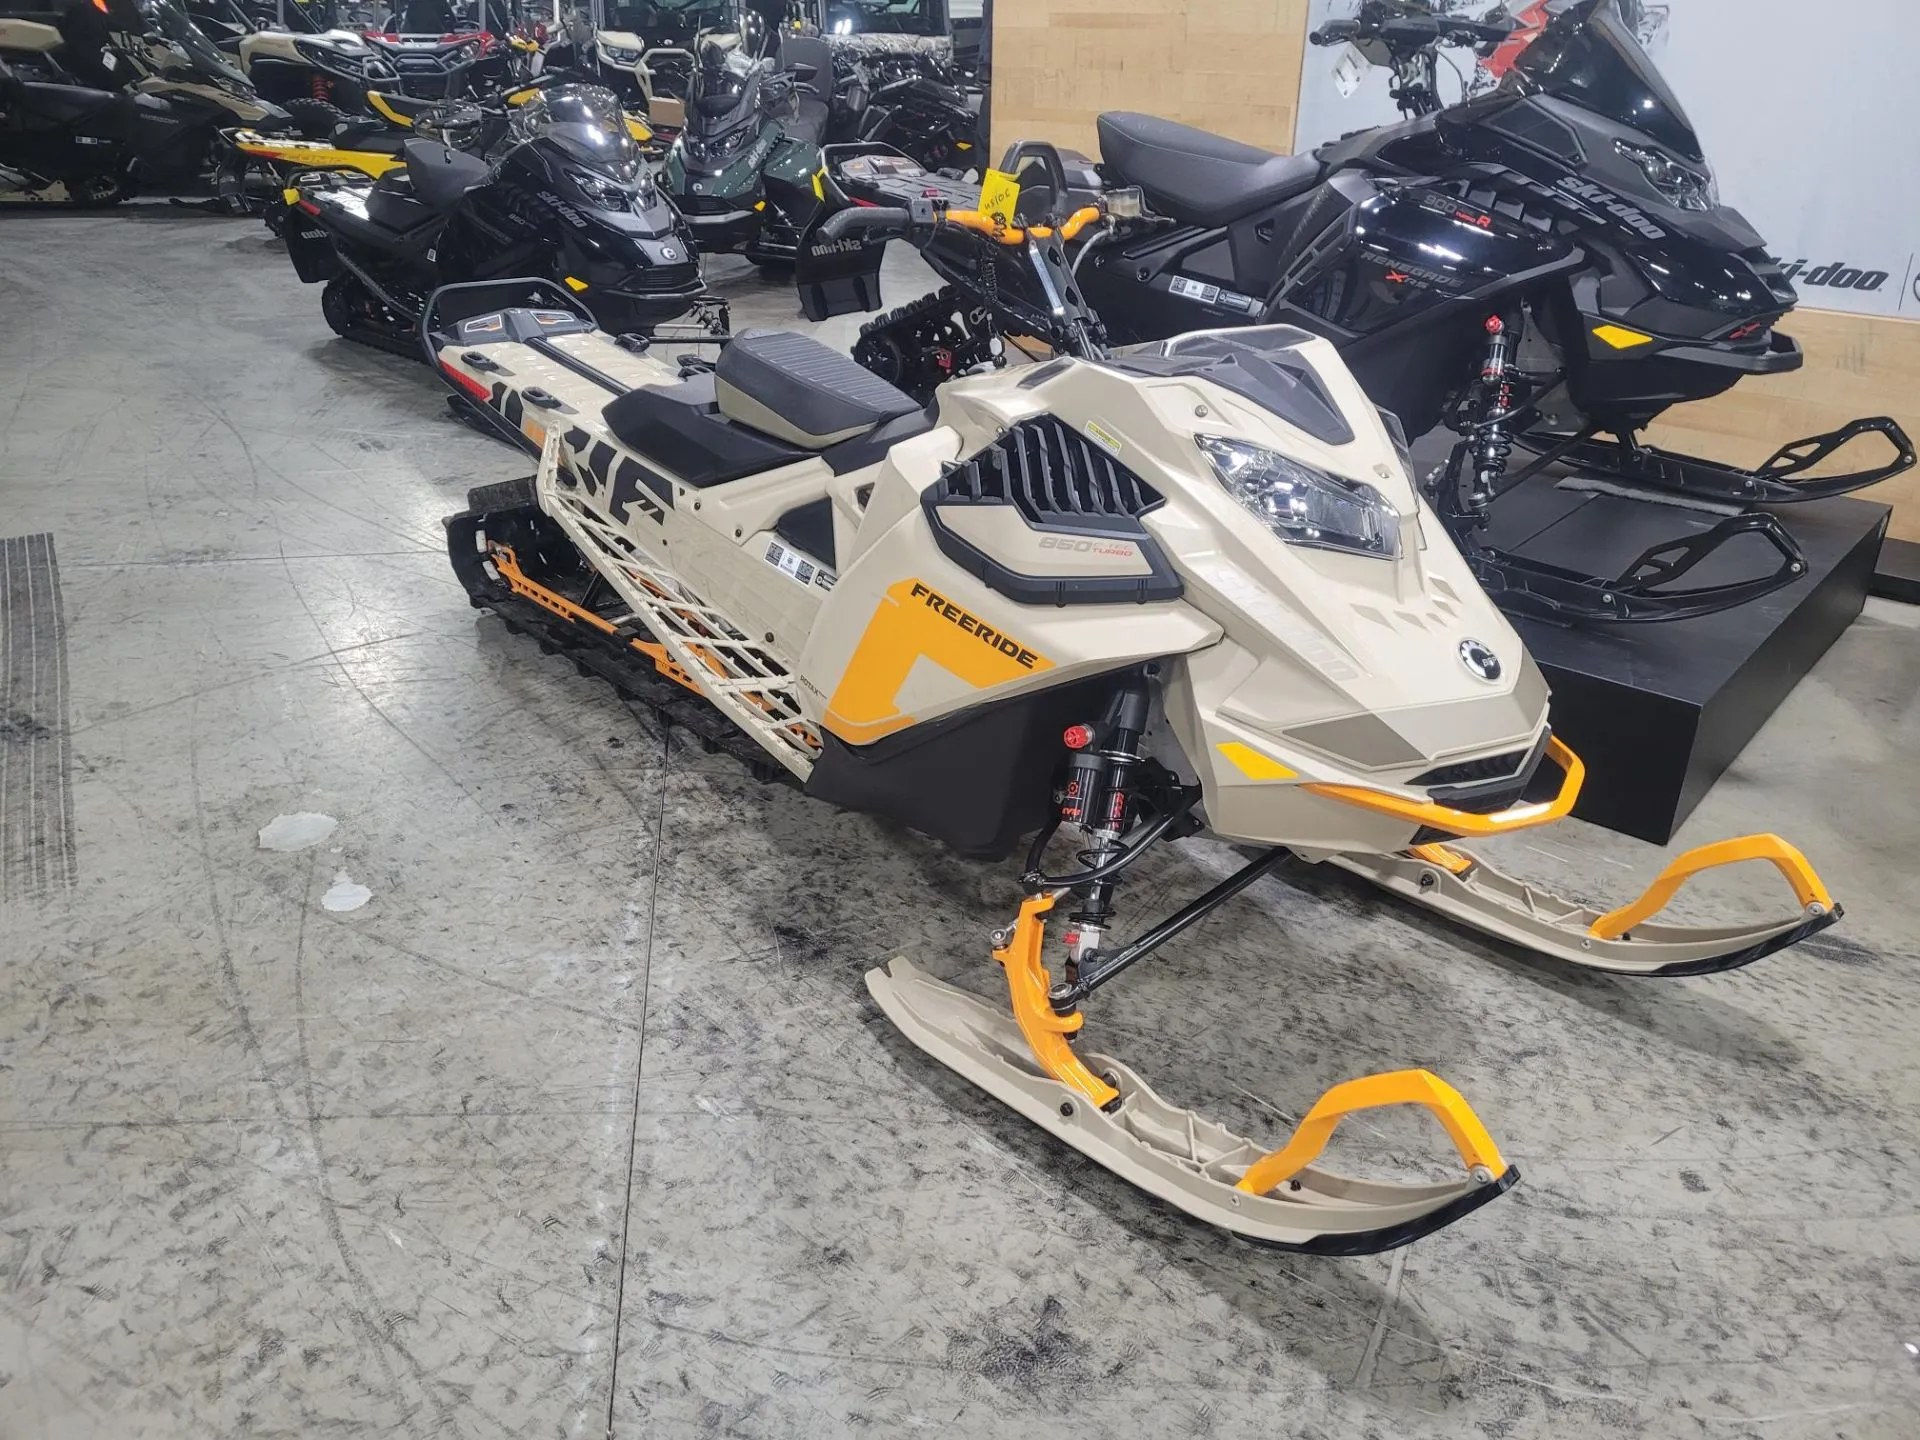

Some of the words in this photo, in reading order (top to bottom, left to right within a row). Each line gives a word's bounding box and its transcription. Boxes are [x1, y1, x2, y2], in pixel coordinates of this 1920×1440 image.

[536, 191, 588, 228] ski-doo
[1424, 194, 1458, 213] 900
[1556, 177, 1667, 240] ski-doo
[1360, 251, 1465, 288] RENEGADE
[1038, 536, 1092, 553] 850
[1091, 547, 1134, 558] TURBO
[910, 582, 1038, 670] FREERIDE
